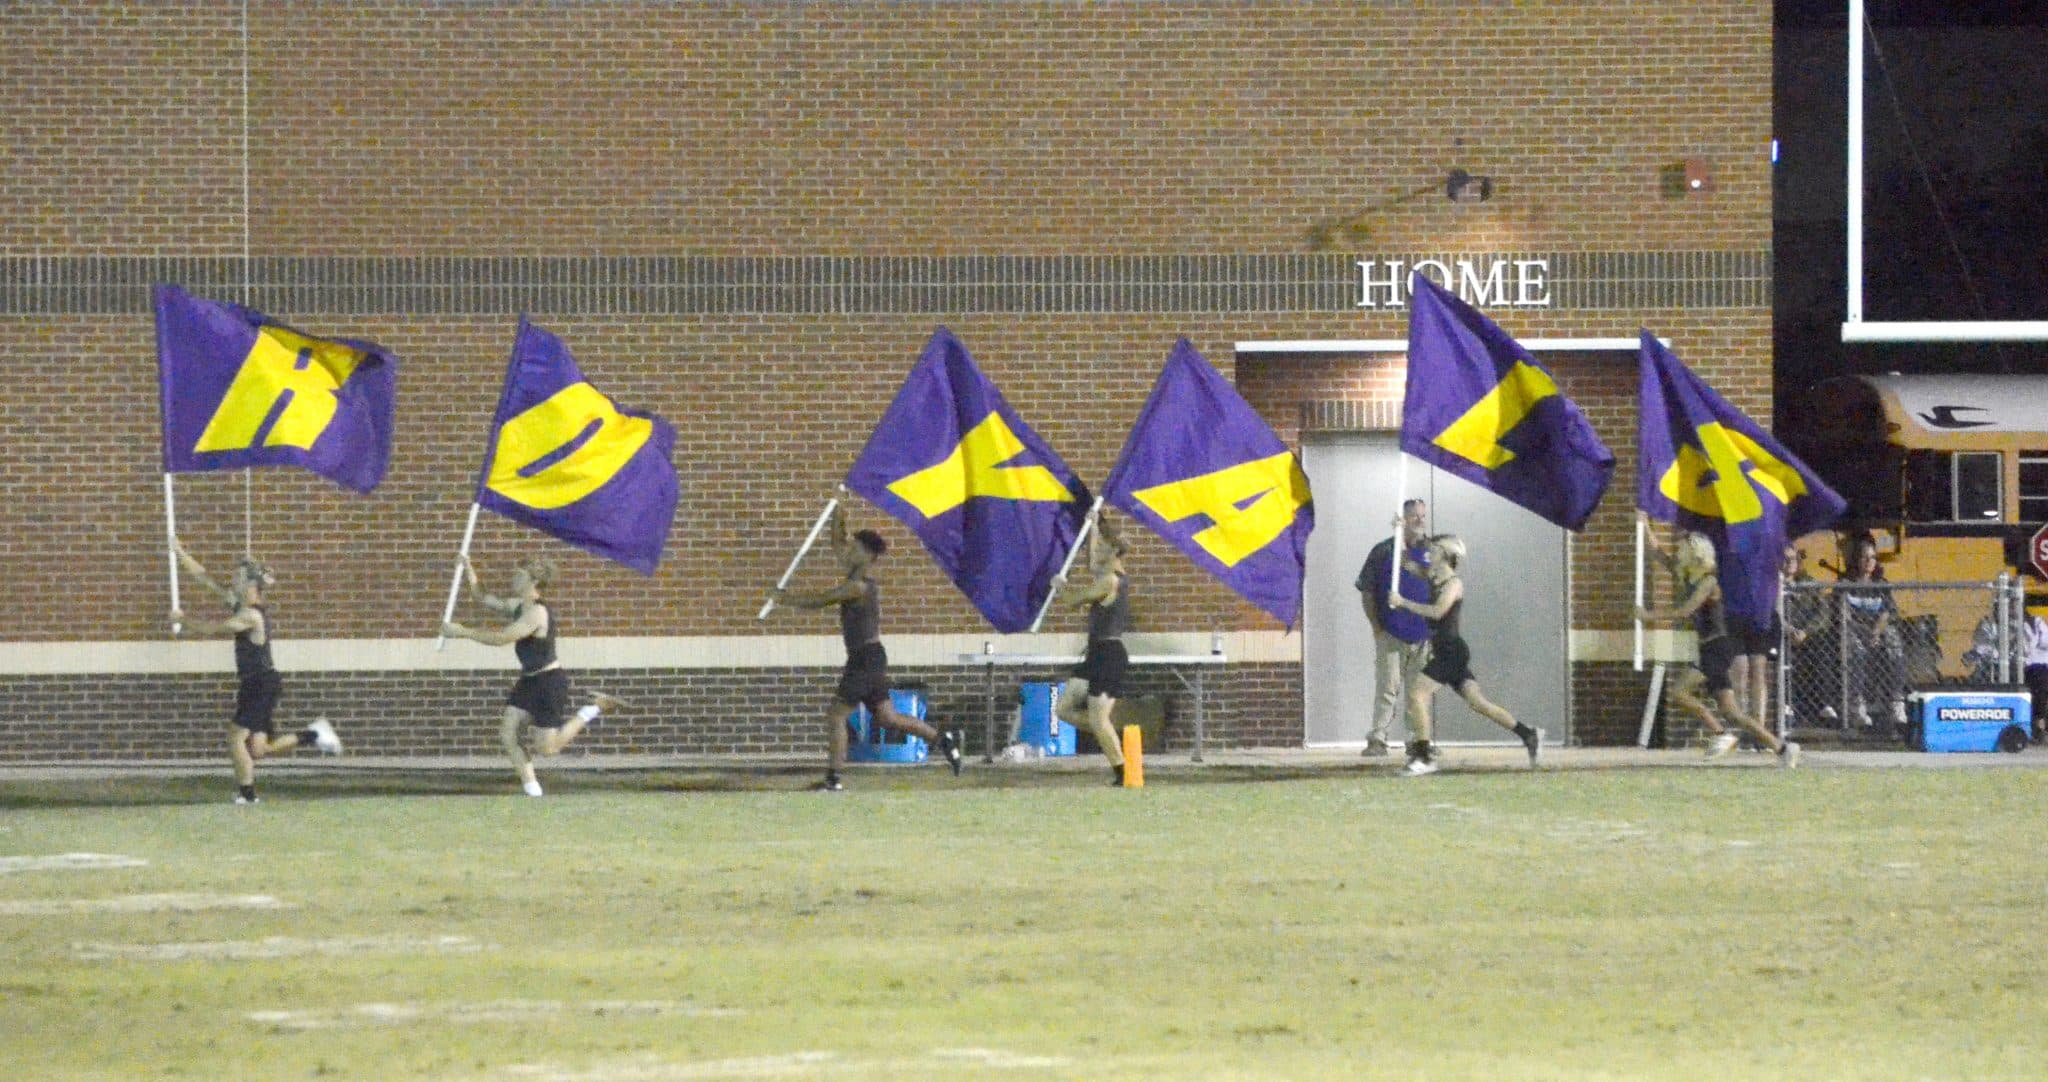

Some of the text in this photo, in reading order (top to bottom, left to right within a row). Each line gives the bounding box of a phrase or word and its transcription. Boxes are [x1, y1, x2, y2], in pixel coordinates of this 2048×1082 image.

[1357, 260, 1550, 306] HOME
[195, 325, 368, 452] R
[887, 411, 1076, 518] Y
[1131, 451, 1313, 567] A
[1941, 709, 2011, 719] POWERADE
